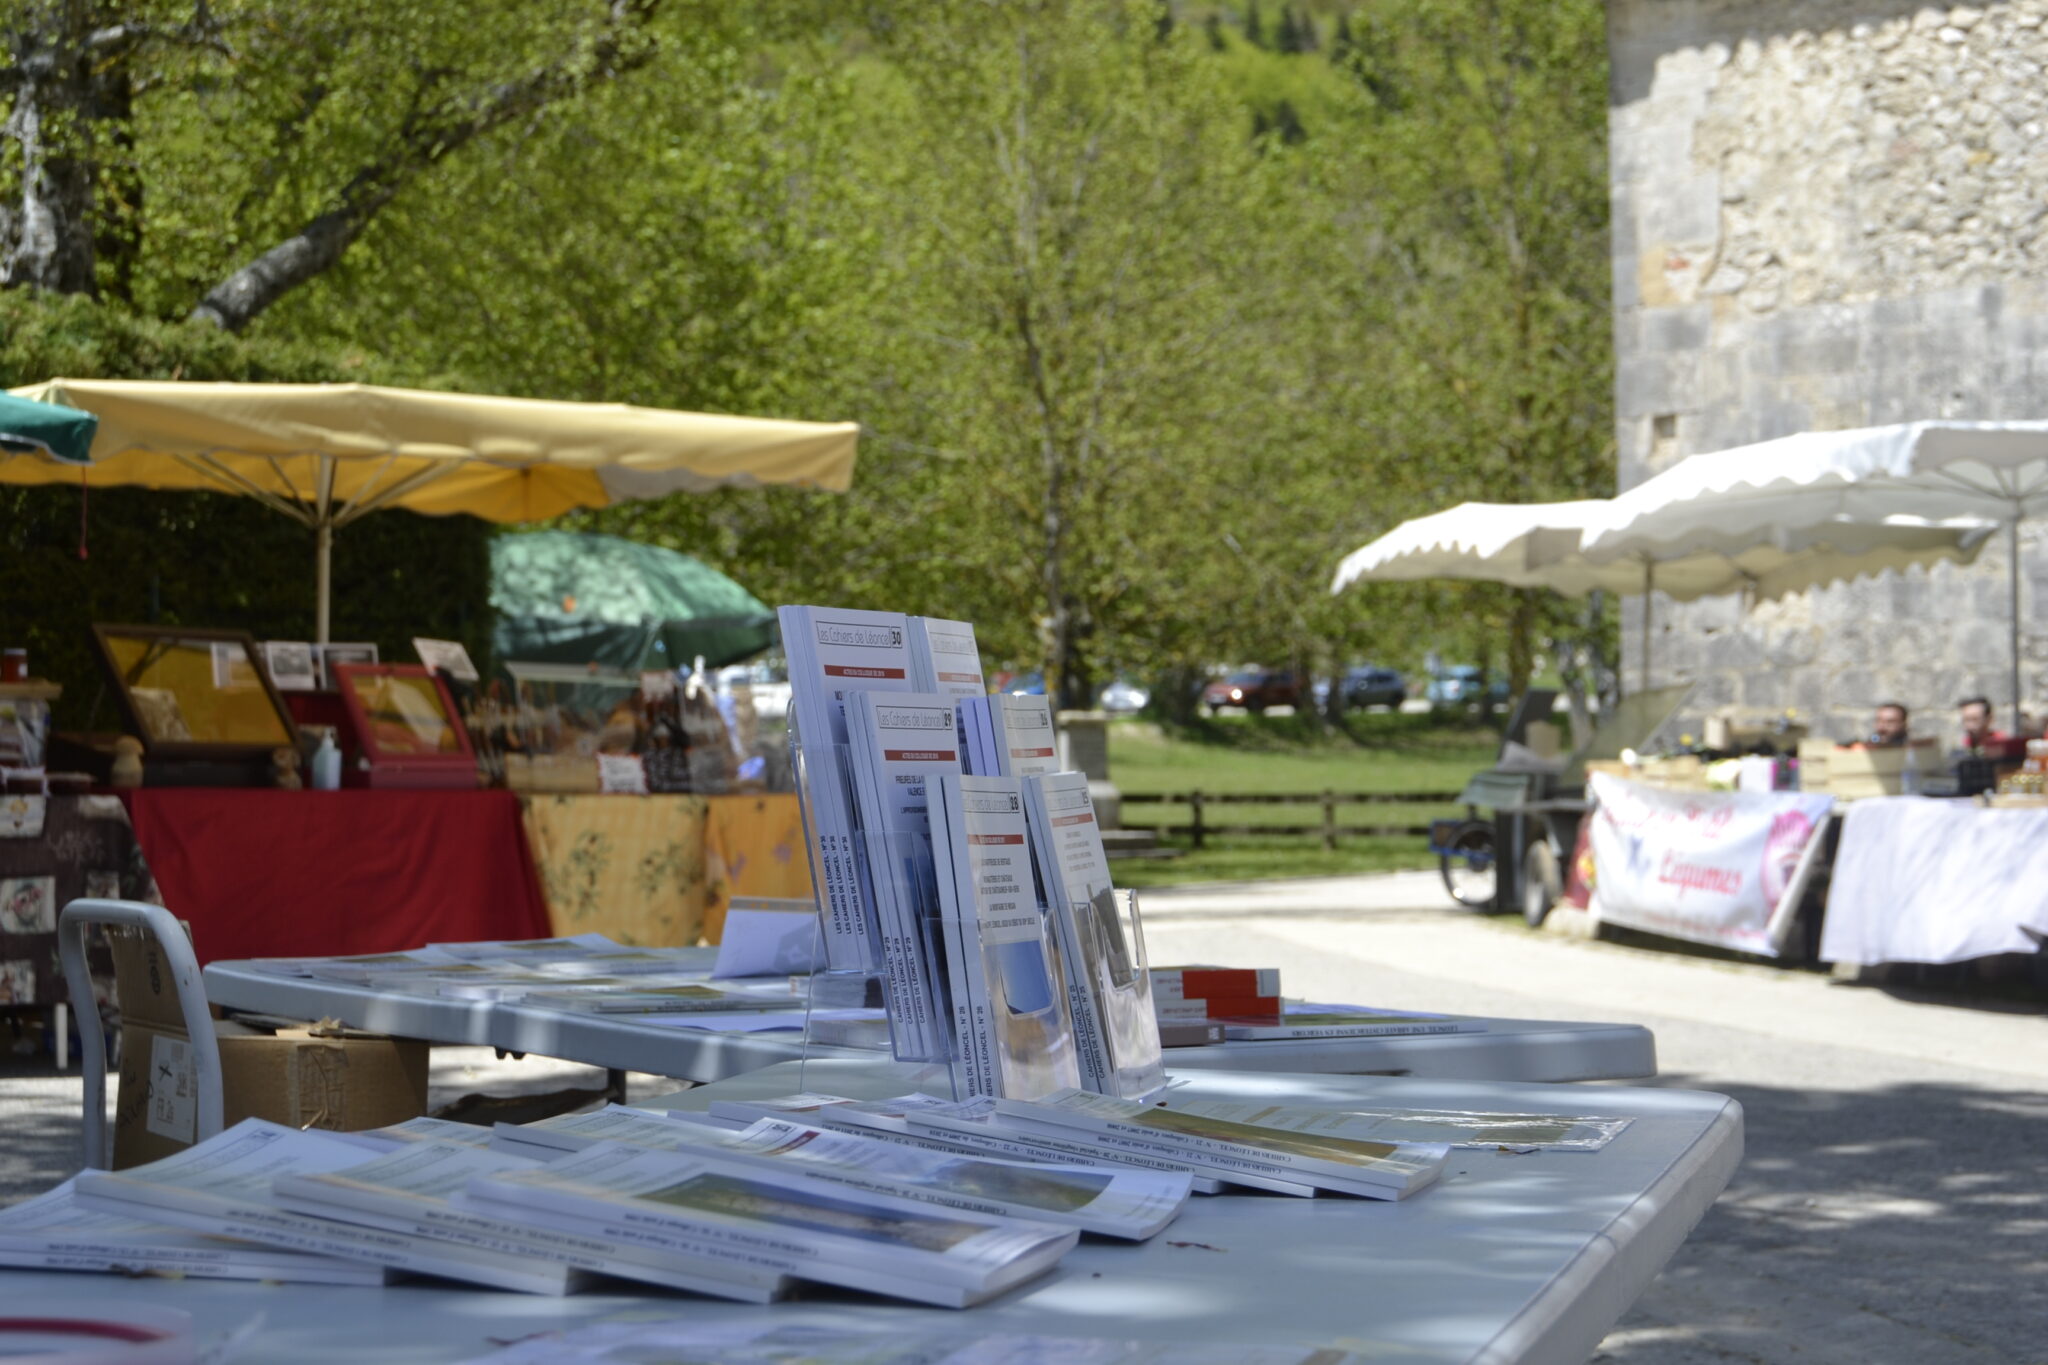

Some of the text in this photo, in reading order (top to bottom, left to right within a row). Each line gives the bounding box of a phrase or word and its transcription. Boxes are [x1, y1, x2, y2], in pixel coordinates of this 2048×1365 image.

[892, 631, 902, 646] 30
[944, 712, 952, 726] 29
[1010, 796, 1018, 810] 28
[824, 856, 833, 883] LÉONCEL
[834, 856, 842, 884] LÉONCEL
[846, 856, 854, 884] LÉONCEL
[831, 895, 840, 921] CAHIERS
[841, 895, 849, 921] CAHIERS
[853, 895, 861, 922] CAHIERS
